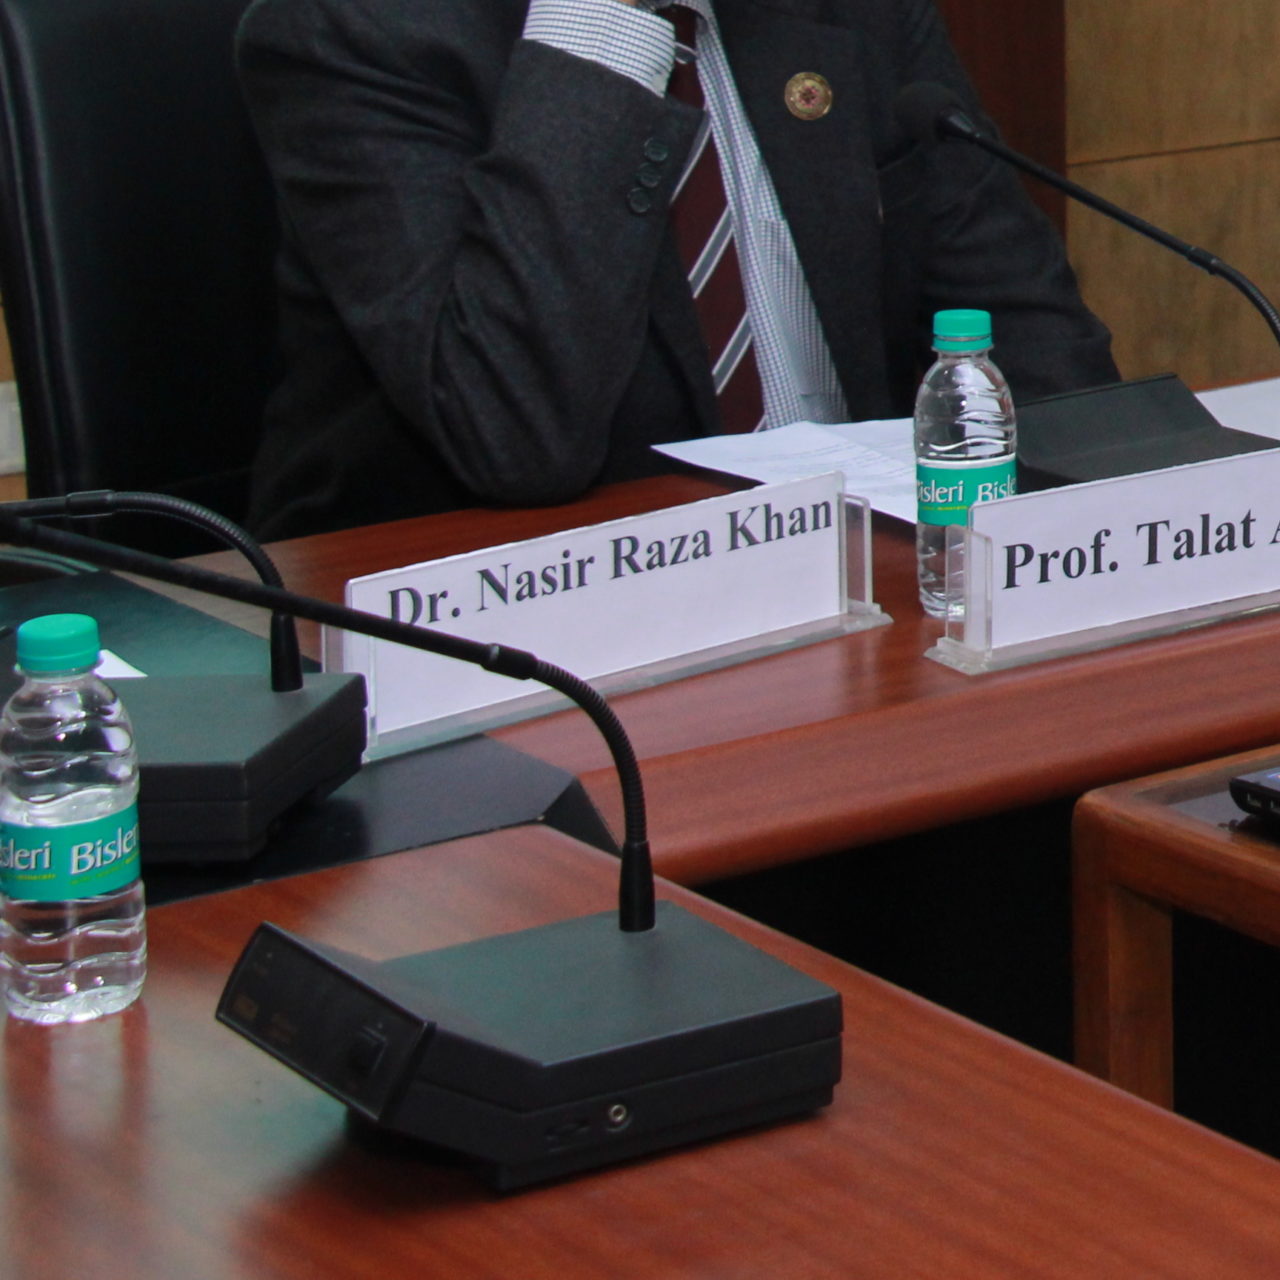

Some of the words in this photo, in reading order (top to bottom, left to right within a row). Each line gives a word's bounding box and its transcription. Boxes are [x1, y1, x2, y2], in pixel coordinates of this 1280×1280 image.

[917, 479, 964, 503] isleri
[387, 585, 461, 625] Dr.
[477, 548, 596, 612] Nasir
[609, 529, 712, 580] Raza
[726, 500, 833, 552] Khan
[1002, 528, 1119, 590] Prof.
[1136, 509, 1257, 566] Talat
[0, 838, 52, 870] sleri
